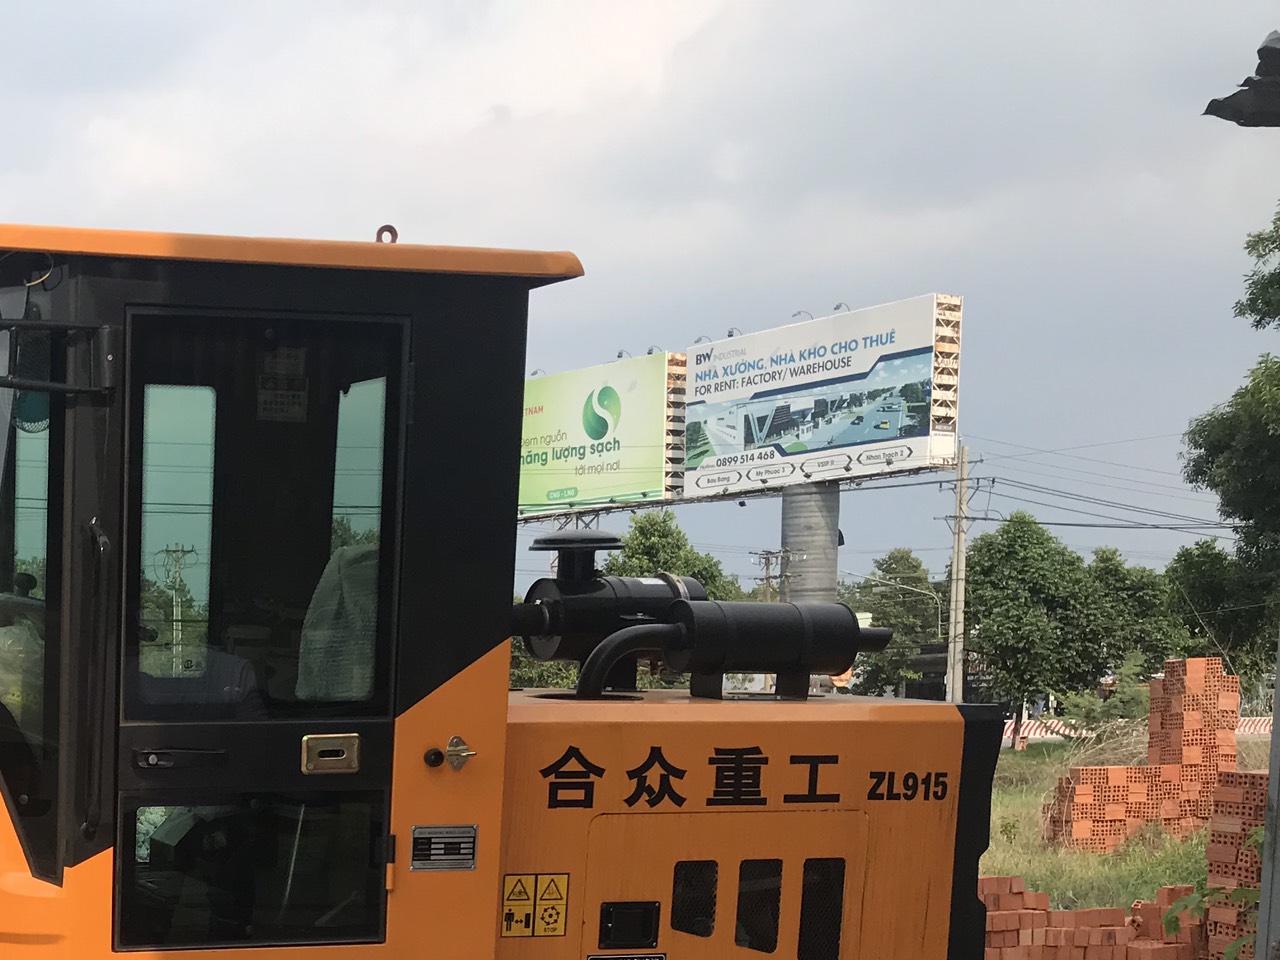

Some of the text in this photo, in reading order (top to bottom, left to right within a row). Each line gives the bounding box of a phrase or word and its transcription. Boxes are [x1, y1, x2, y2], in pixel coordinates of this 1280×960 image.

[695, 364, 719, 383] NHÀ
[770, 349, 796, 368] NHÀ
[799, 345, 827, 363] KHO
[830, 339, 859, 355] CHO
[862, 328, 896, 349] THUÊ
[696, 347, 747, 366] BW INDUSTRIAL
[694, 383, 712, 397] FOR
[714, 378, 739, 393] RENT:
[523, 405, 544, 416] TNAM
[552, 445, 586, 463] lượng
[590, 437, 621, 458] sạch
[716, 455, 738, 468] 0899
[740, 453, 755, 464] 514
[757, 450, 775, 461] 468
[539, 745, 841, 809] 合众重工
[867, 772, 948, 801] ZL915
